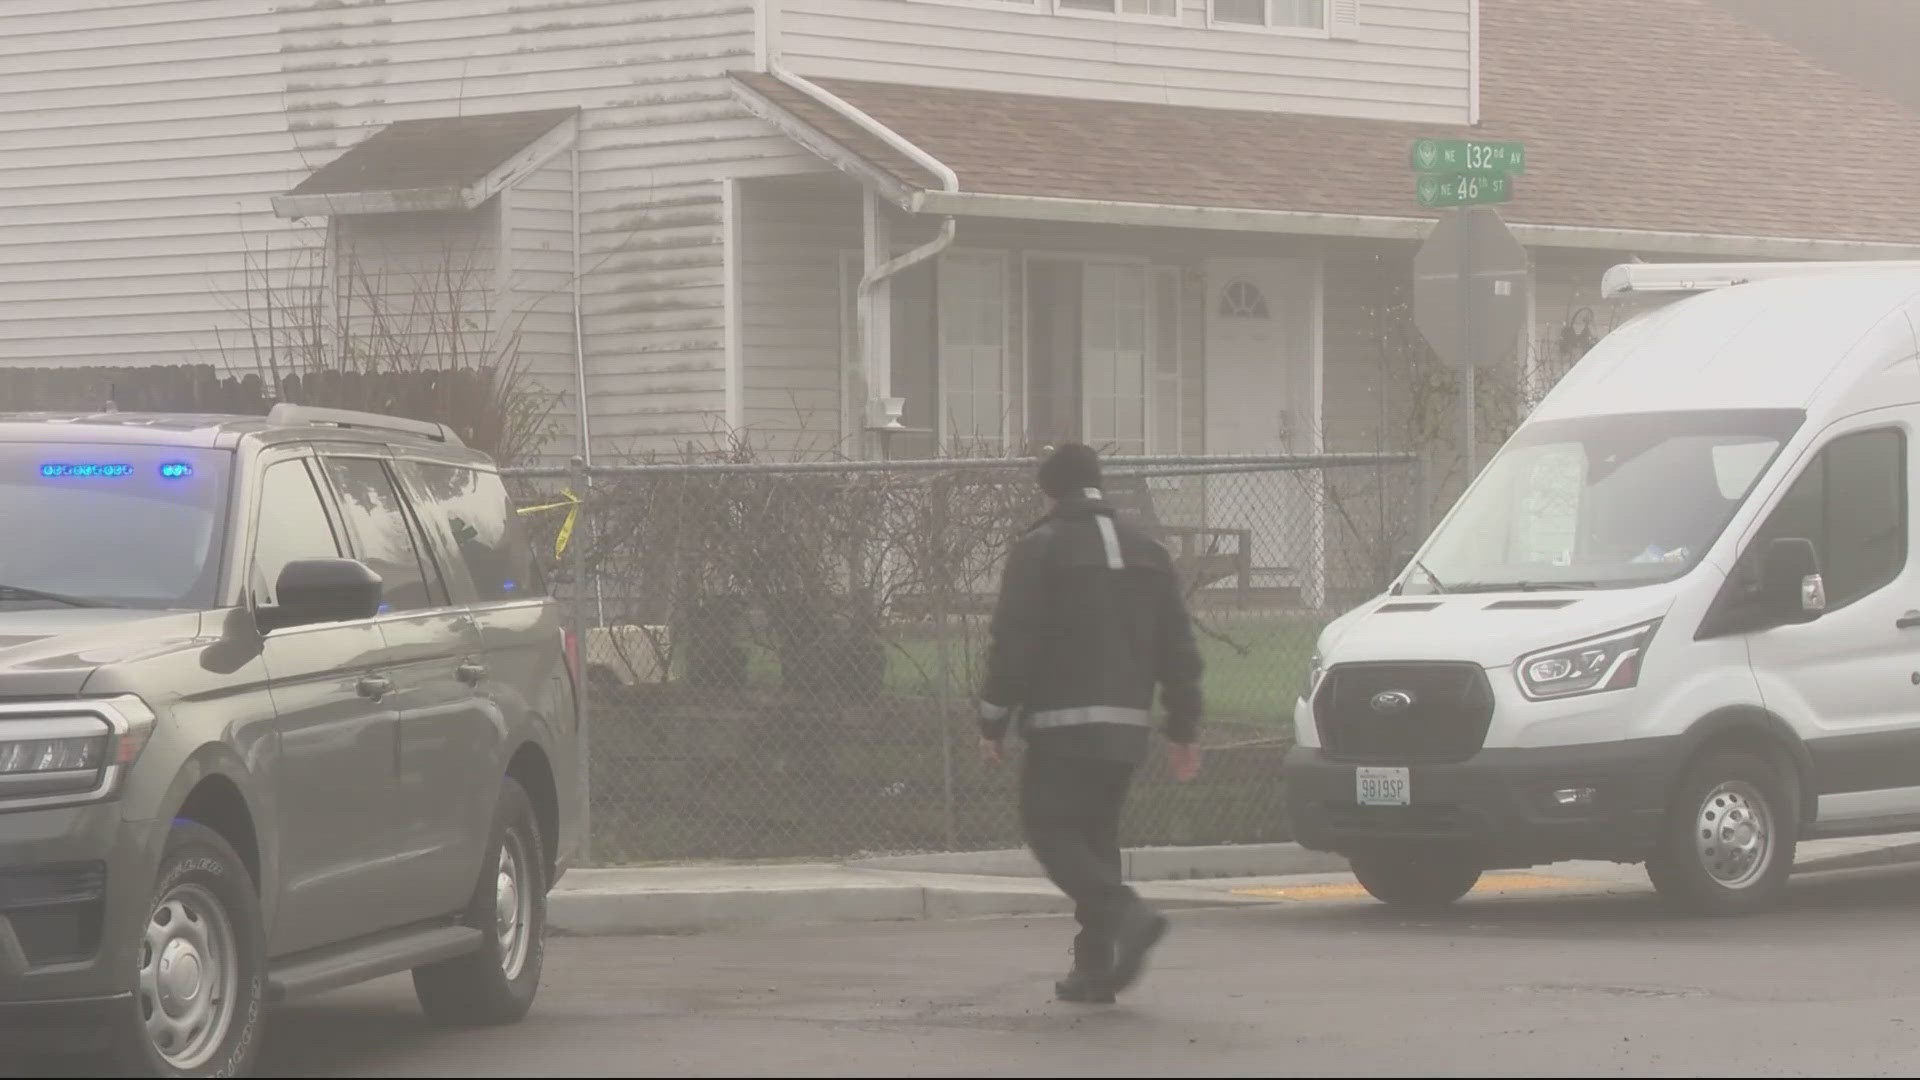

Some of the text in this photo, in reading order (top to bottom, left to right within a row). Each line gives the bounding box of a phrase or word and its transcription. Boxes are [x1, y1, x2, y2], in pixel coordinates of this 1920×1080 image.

[1444, 149, 1456, 162] NE
[1510, 151, 1521, 164] AV
[1440, 183, 1452, 196] NE
[1492, 180, 1504, 192] ST
[1362, 779, 1404, 798] 9819SP
